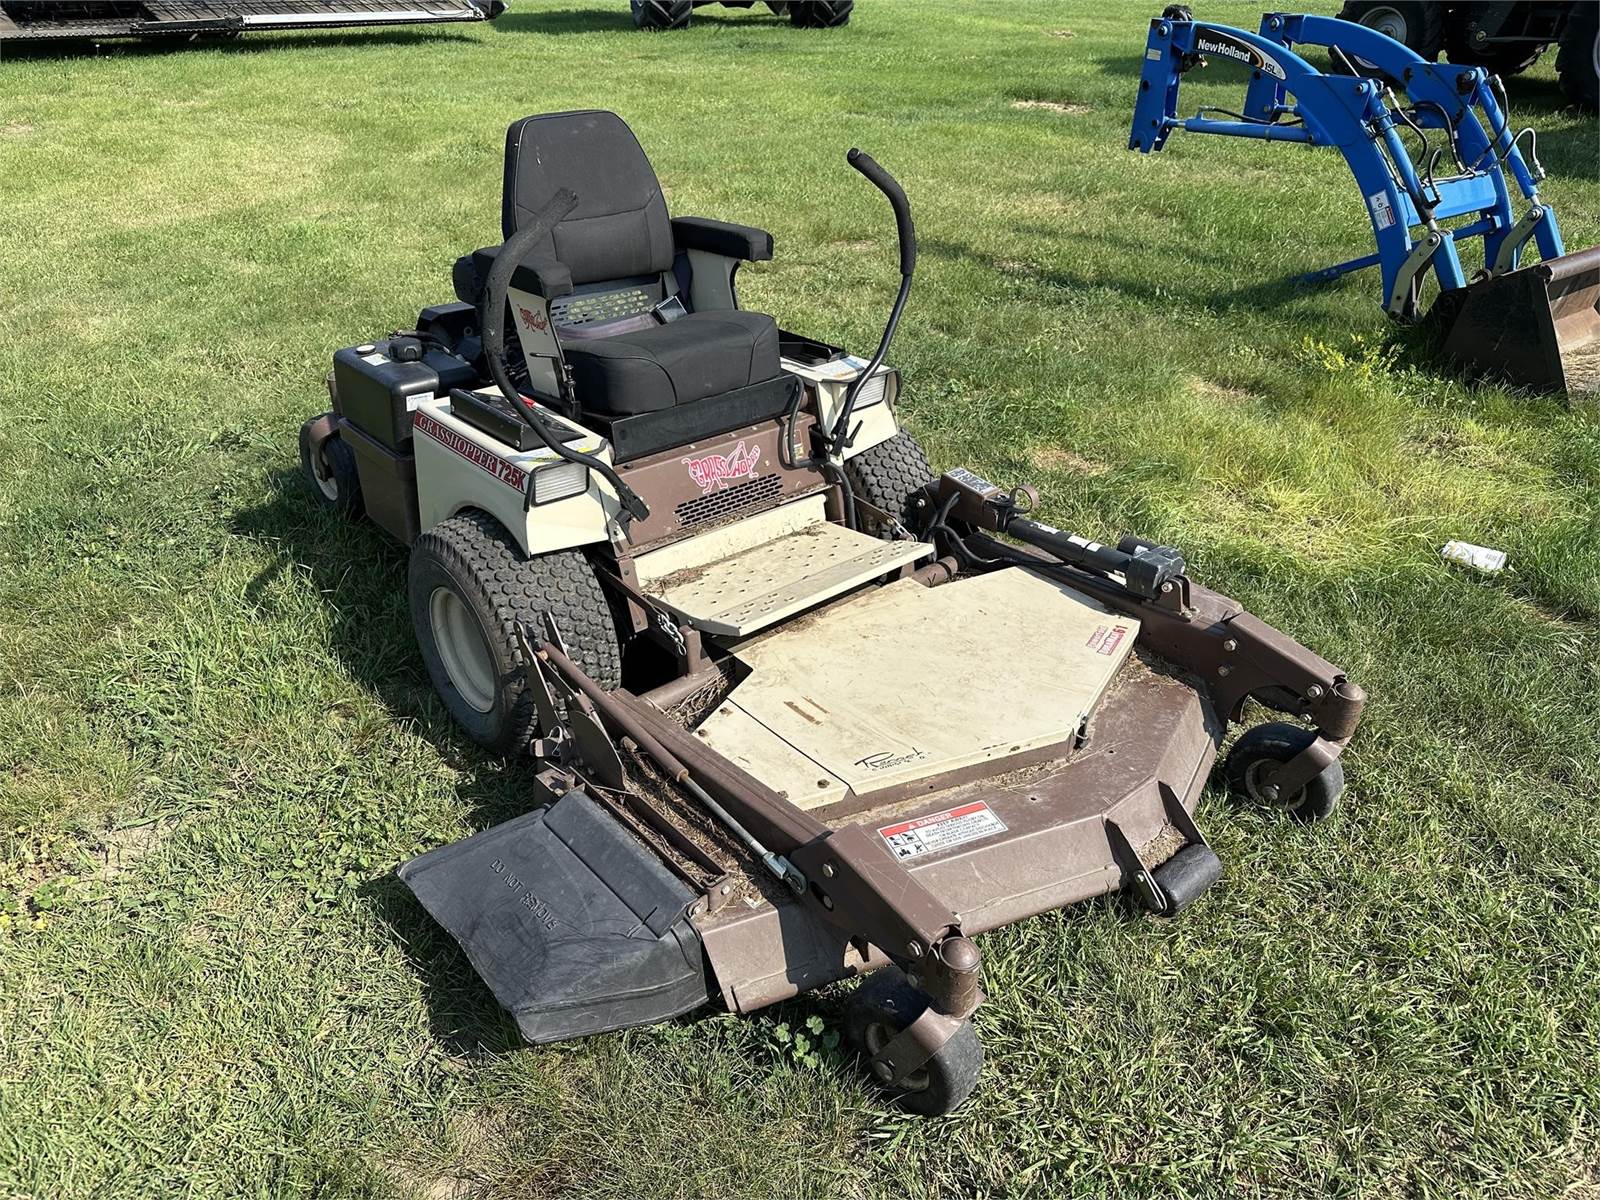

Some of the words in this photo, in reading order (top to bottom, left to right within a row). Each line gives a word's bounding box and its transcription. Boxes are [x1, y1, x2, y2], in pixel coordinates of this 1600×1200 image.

[1198, 39, 1218, 52] New
[1218, 42, 1251, 62] Holland
[419, 415, 496, 473] GRASSHOPPER
[498, 461, 526, 492] 725K
[917, 811, 953, 827] DANGER
[489, 857, 506, 874] DO
[503, 872, 525, 893] NOT
[520, 891, 560, 930] REMOVE
